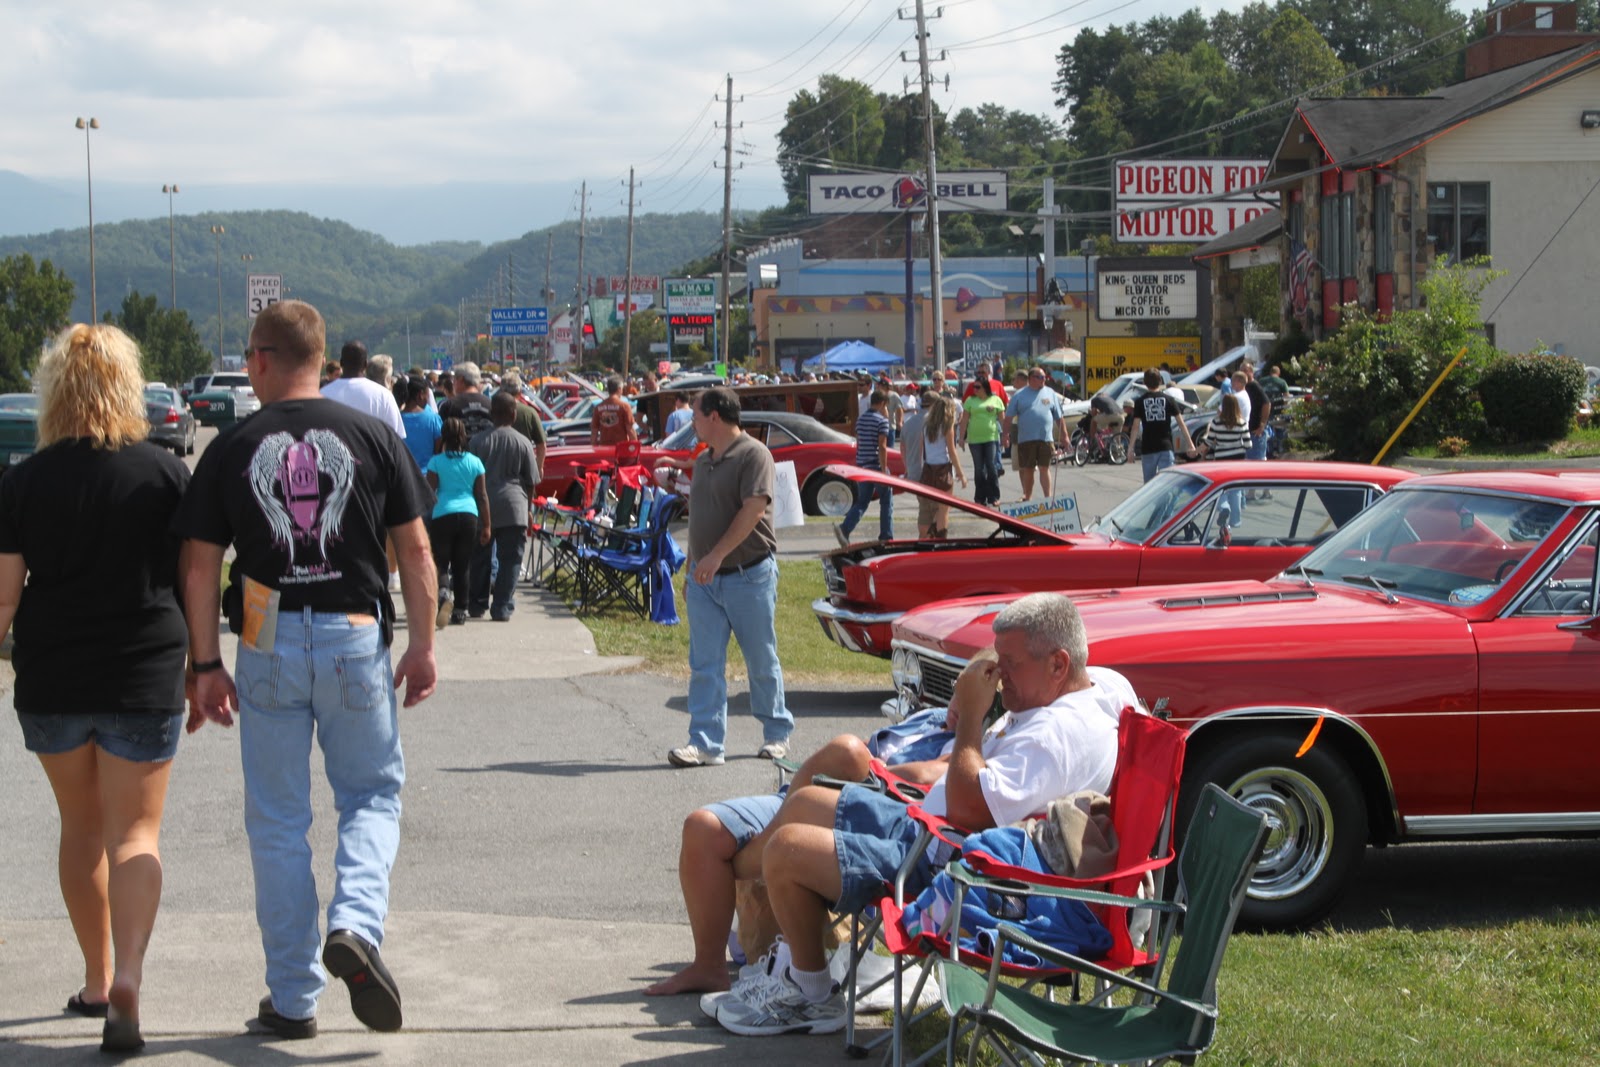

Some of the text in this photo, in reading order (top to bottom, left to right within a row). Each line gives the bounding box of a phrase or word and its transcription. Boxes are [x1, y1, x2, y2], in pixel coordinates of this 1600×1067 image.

[1118, 165, 1213, 195] PIGEON
[819, 183, 997, 199] TACO BELL
[1118, 207, 1218, 237] MOTOR
[250, 278, 280, 287] SPEED
[1163, 274, 1186, 285] BEDS
[253, 288, 276, 296] LIMIT
[1131, 295, 1164, 306] COFFEE
[493, 310, 537, 319] VALLEY DR
[1115, 306, 1171, 317] MICRO FRIG
[671, 315, 713, 325] ALL ITEMS
[980, 320, 1025, 330] SUNDAY
[493, 324, 503, 334] CITY
[966, 341, 992, 351] FIRST
[1112, 355, 1126, 367] UP
[209, 402, 226, 412] 3270
[1053, 522, 1075, 534] Here
